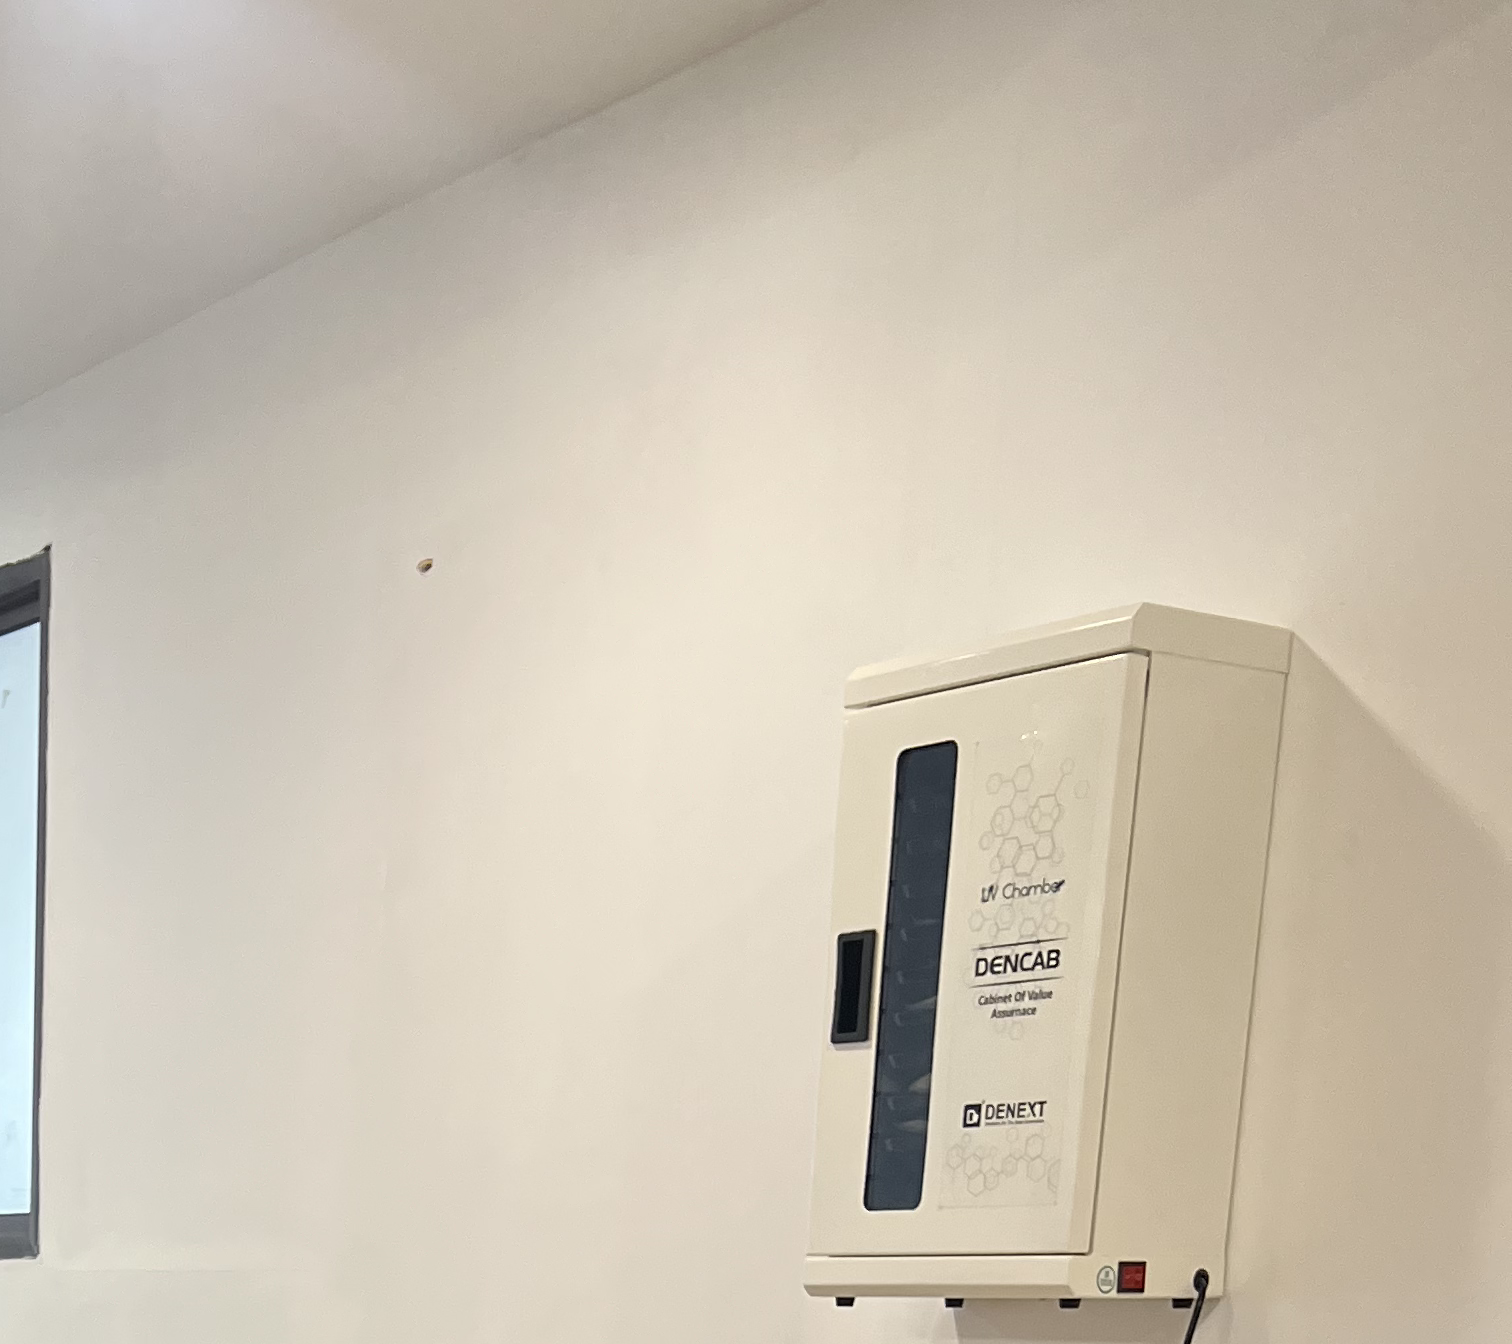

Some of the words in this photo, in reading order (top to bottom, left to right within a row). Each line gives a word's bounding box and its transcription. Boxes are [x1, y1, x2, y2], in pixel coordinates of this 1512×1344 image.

[1002, 877, 1065, 900] Chamber
[974, 949, 1061, 977] DENCAB
[977, 993, 1012, 1006] Cabinet
[1028, 989, 1053, 1001] Value
[985, 1101, 1047, 1119] DENEXT
